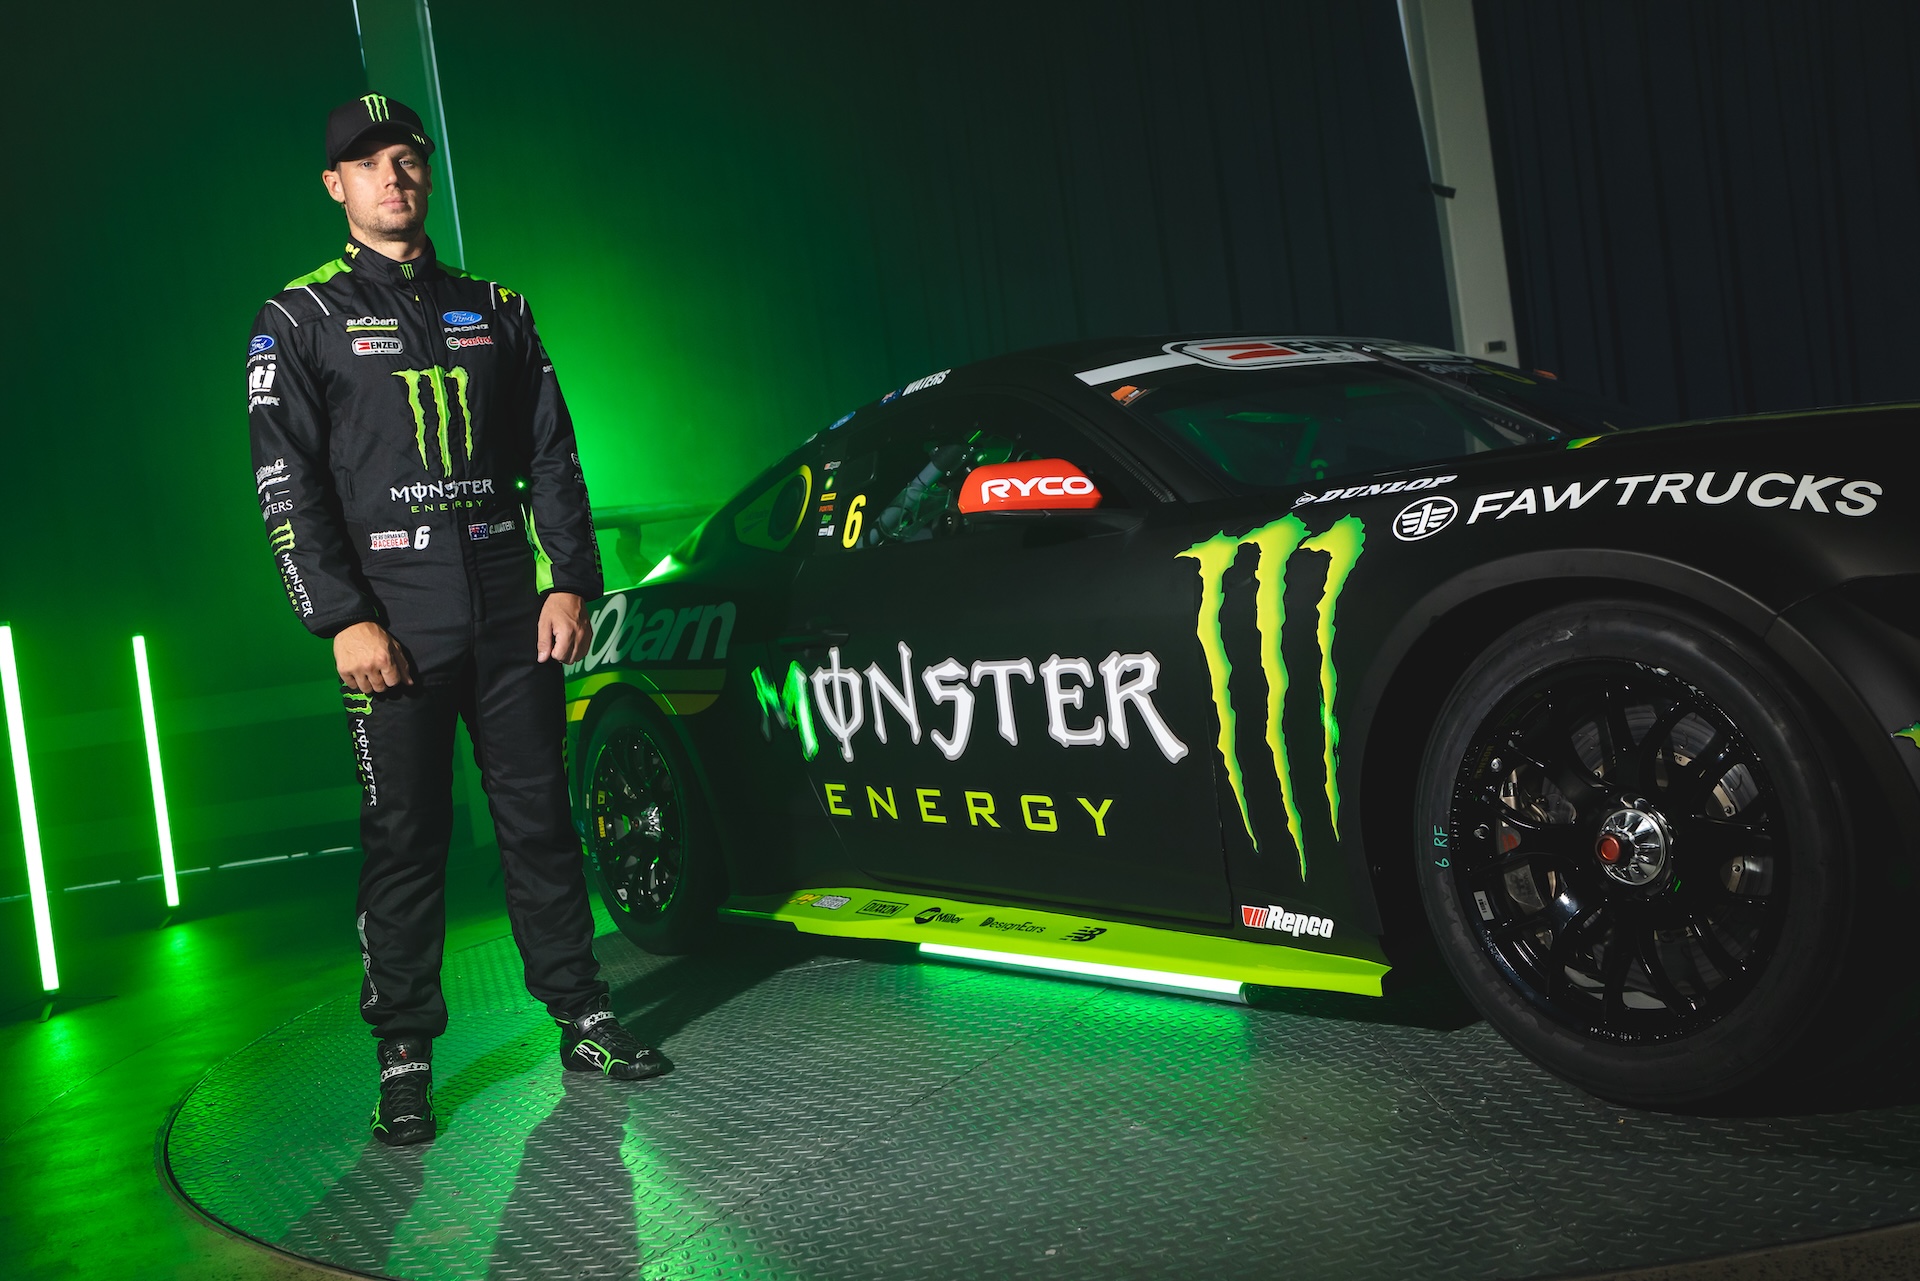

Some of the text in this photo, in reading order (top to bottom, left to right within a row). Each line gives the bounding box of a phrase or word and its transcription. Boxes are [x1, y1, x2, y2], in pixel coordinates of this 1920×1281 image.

[444, 324, 489, 333] RACING
[371, 341, 399, 350] ENZED
[902, 369, 951, 397] WATERS
[389, 479, 495, 503] MONSTER
[981, 476, 1095, 505] RYCO
[1314, 475, 1458, 503] DUNLOP
[1466, 471, 1883, 525] FAW TRUCKS
[411, 500, 483, 513] ENERGY
[842, 494, 867, 549] 6
[372, 531, 408, 541] PERFORMANCE
[373, 538, 409, 548] RACEGEAR
[414, 526, 431, 550] 6
[281, 553, 314, 618] MONSTER
[750, 640, 1190, 764] MONSTER
[356, 719, 377, 806] MONSTER
[824, 783, 1113, 837] ENERGY
[1433, 824, 1450, 868] 6 RF
[935, 912, 965, 925] Miller
[1265, 904, 1334, 939] Repco
